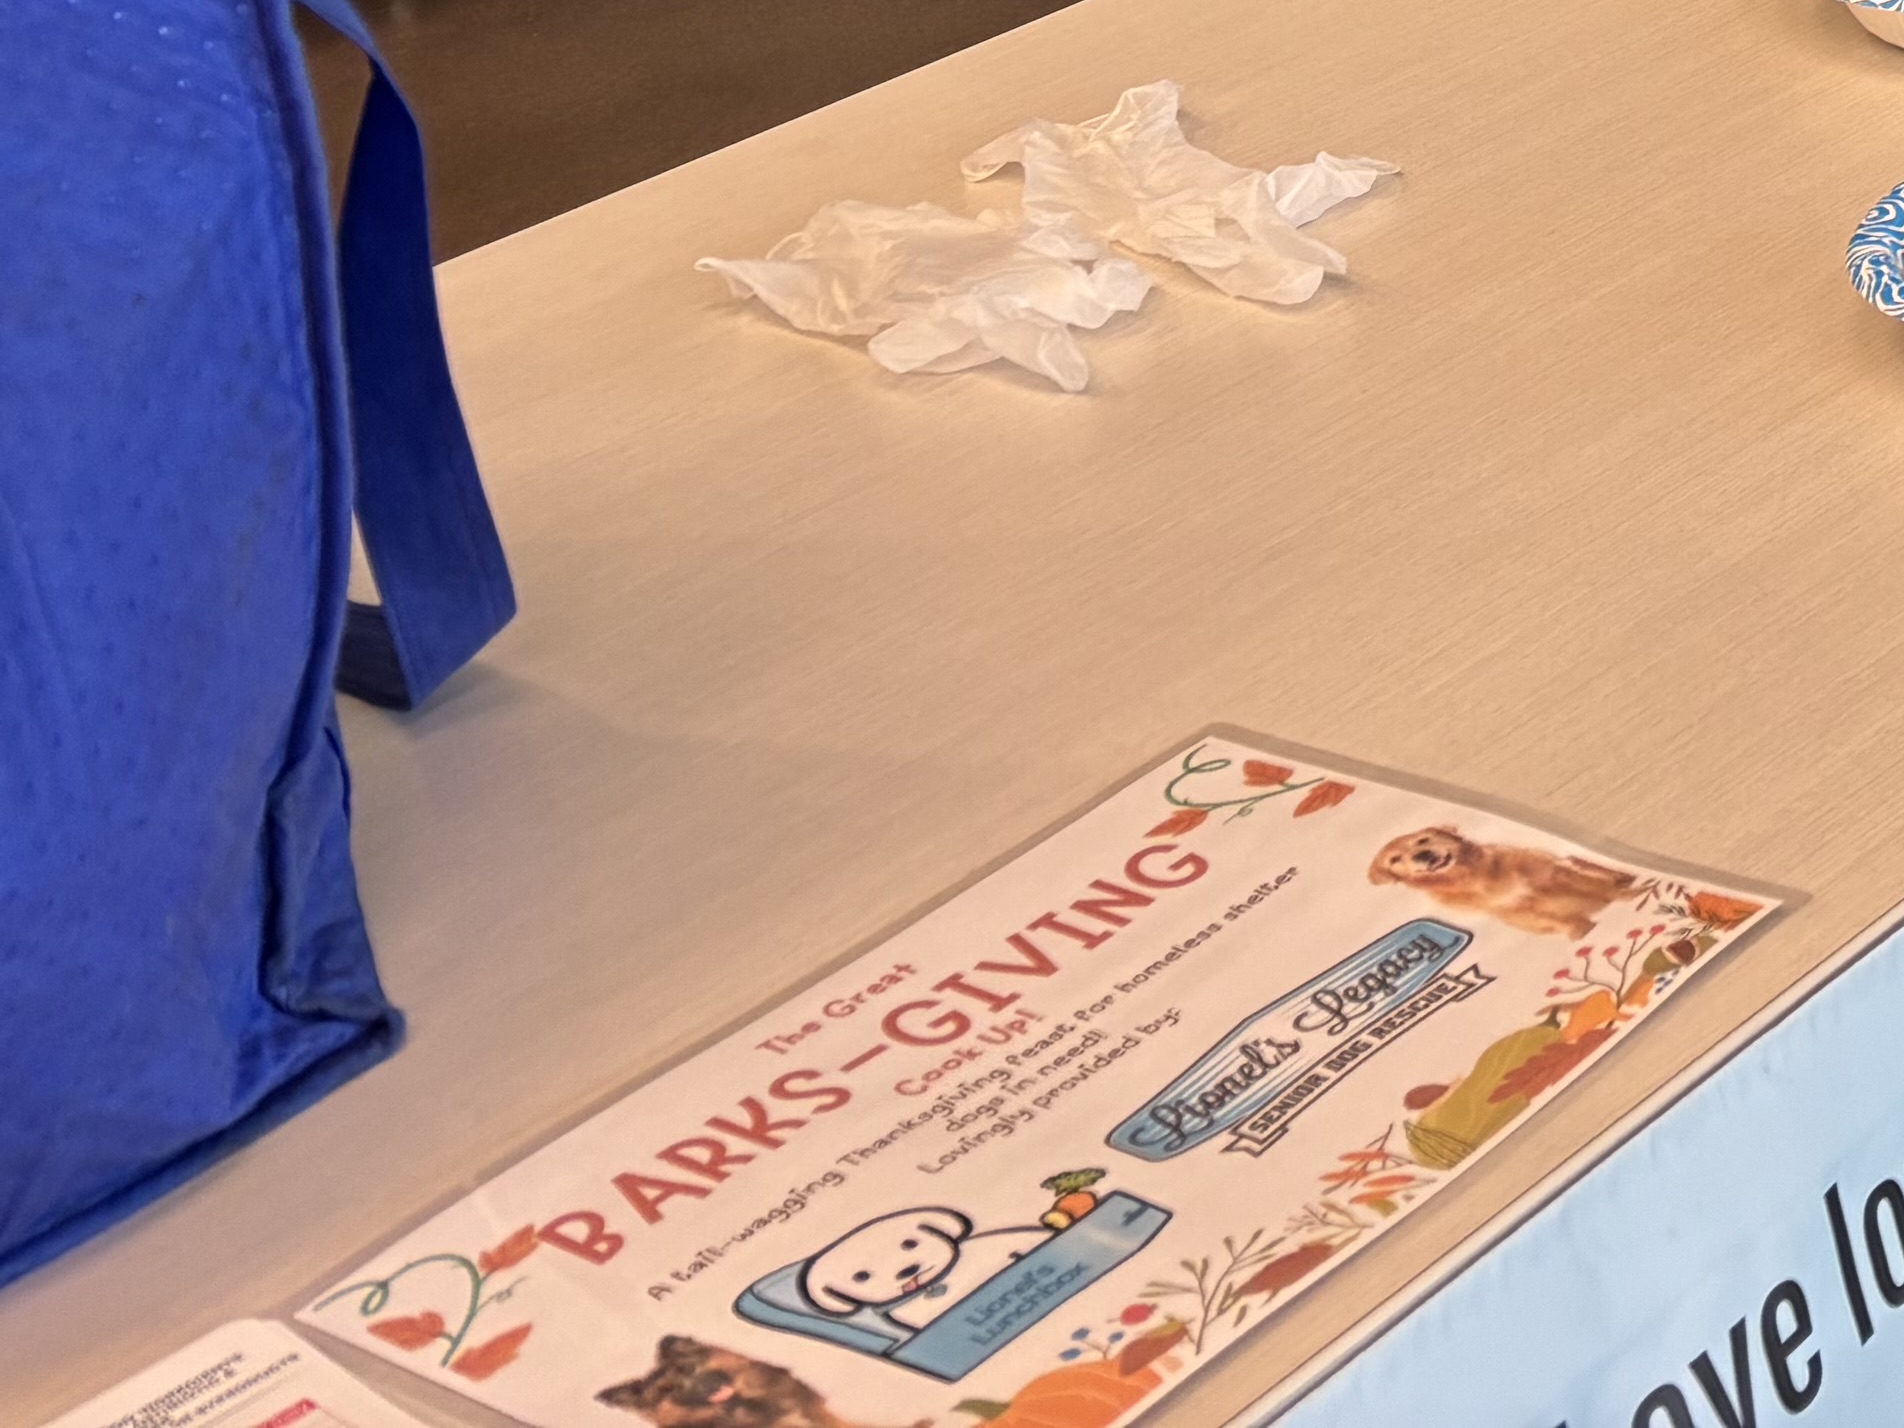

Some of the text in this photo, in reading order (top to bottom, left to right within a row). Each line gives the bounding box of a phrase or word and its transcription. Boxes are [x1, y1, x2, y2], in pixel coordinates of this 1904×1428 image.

[647, 864, 1300, 1302] A tail-wagging Thanksgiving feast for homeless shelter
[755, 961, 918, 1056] The Great
[894, 1008, 1044, 1098] Cook Up!
[945, 1030, 1109, 1135] dogs in need!
[1128, 933, 1461, 1152] Lionel's Legacy
[1249, 979, 1460, 1134] SENIOR DOG RESCUE
[917, 1007, 1184, 1175] Lovingly provided by:
[1553, 1280, 1823, 1428] ve
